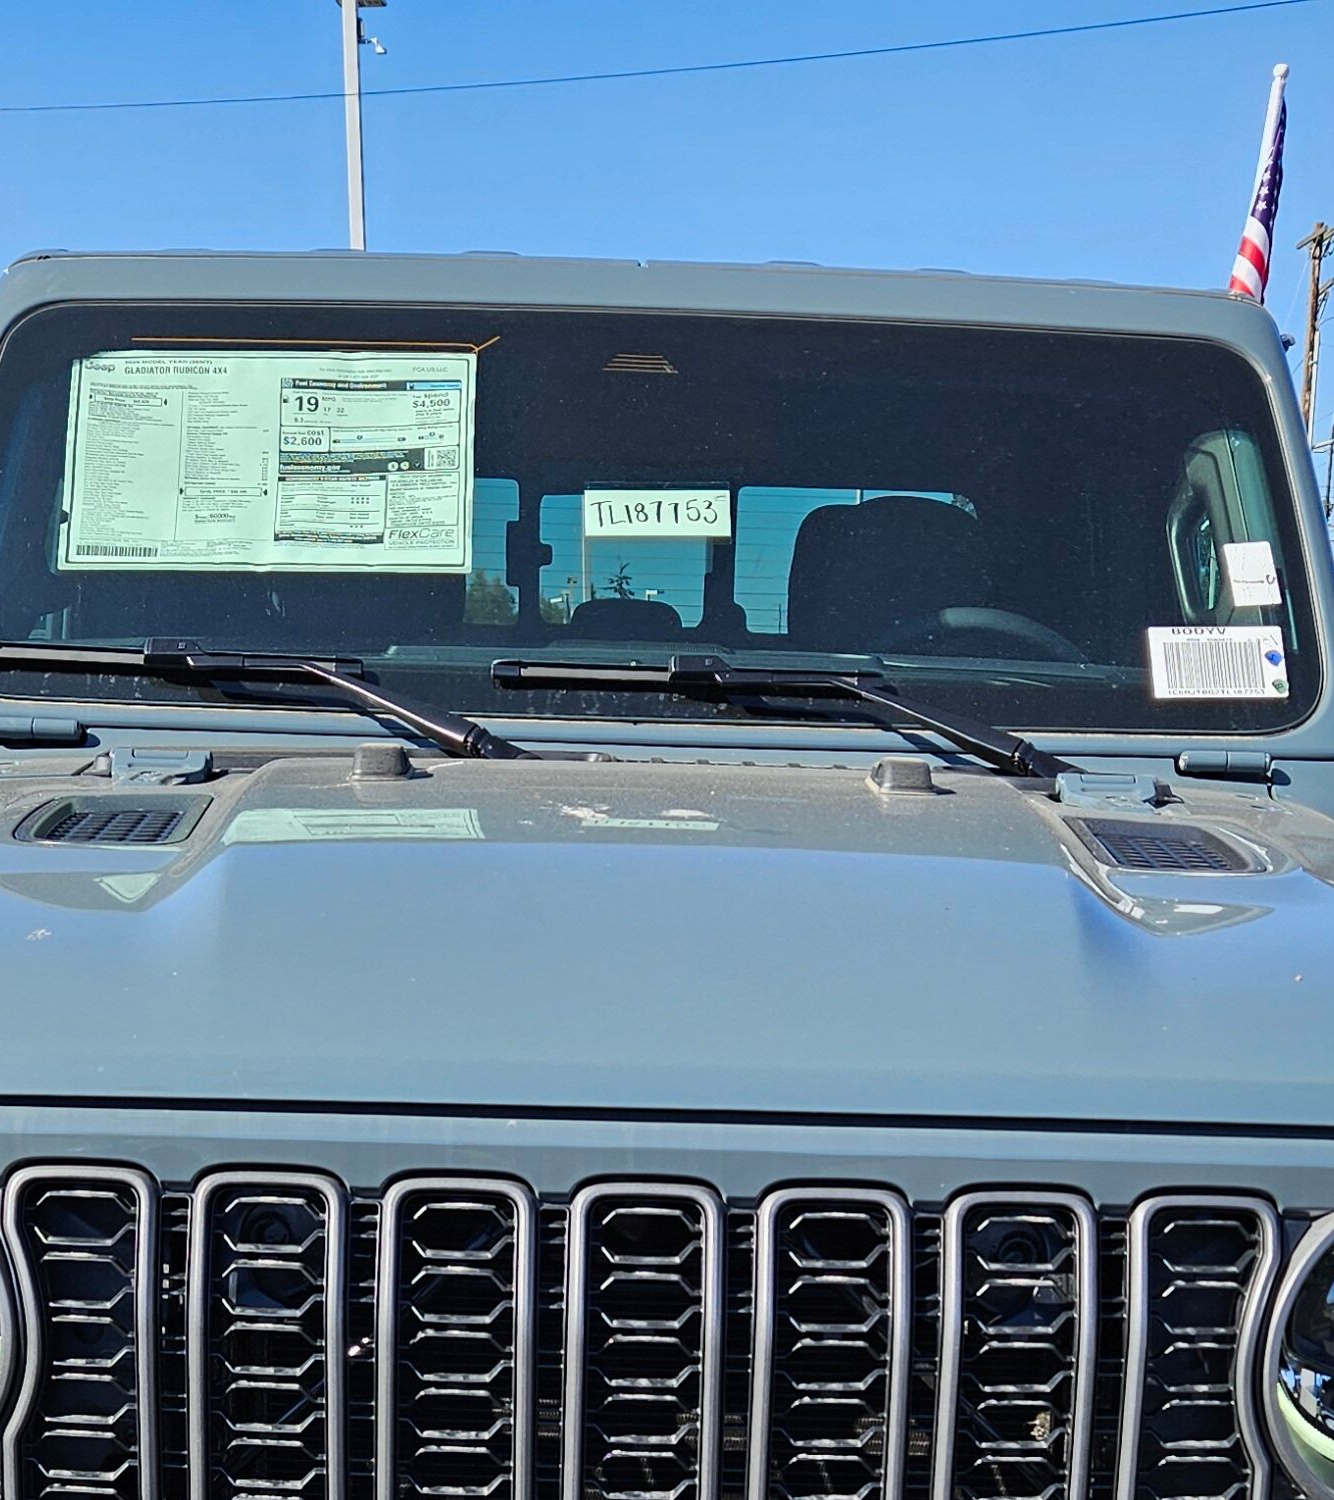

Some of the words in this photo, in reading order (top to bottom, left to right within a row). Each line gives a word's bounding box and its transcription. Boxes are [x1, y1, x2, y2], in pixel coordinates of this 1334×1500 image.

[124, 366, 171, 375] GLADIATOR
[173, 366, 210, 375] RUBICON
[212, 366, 228, 375] 4X4
[294, 395, 319, 412] 19
[283, 436, 322, 446] $2,600
[388, 528, 455, 539] FlexCare
